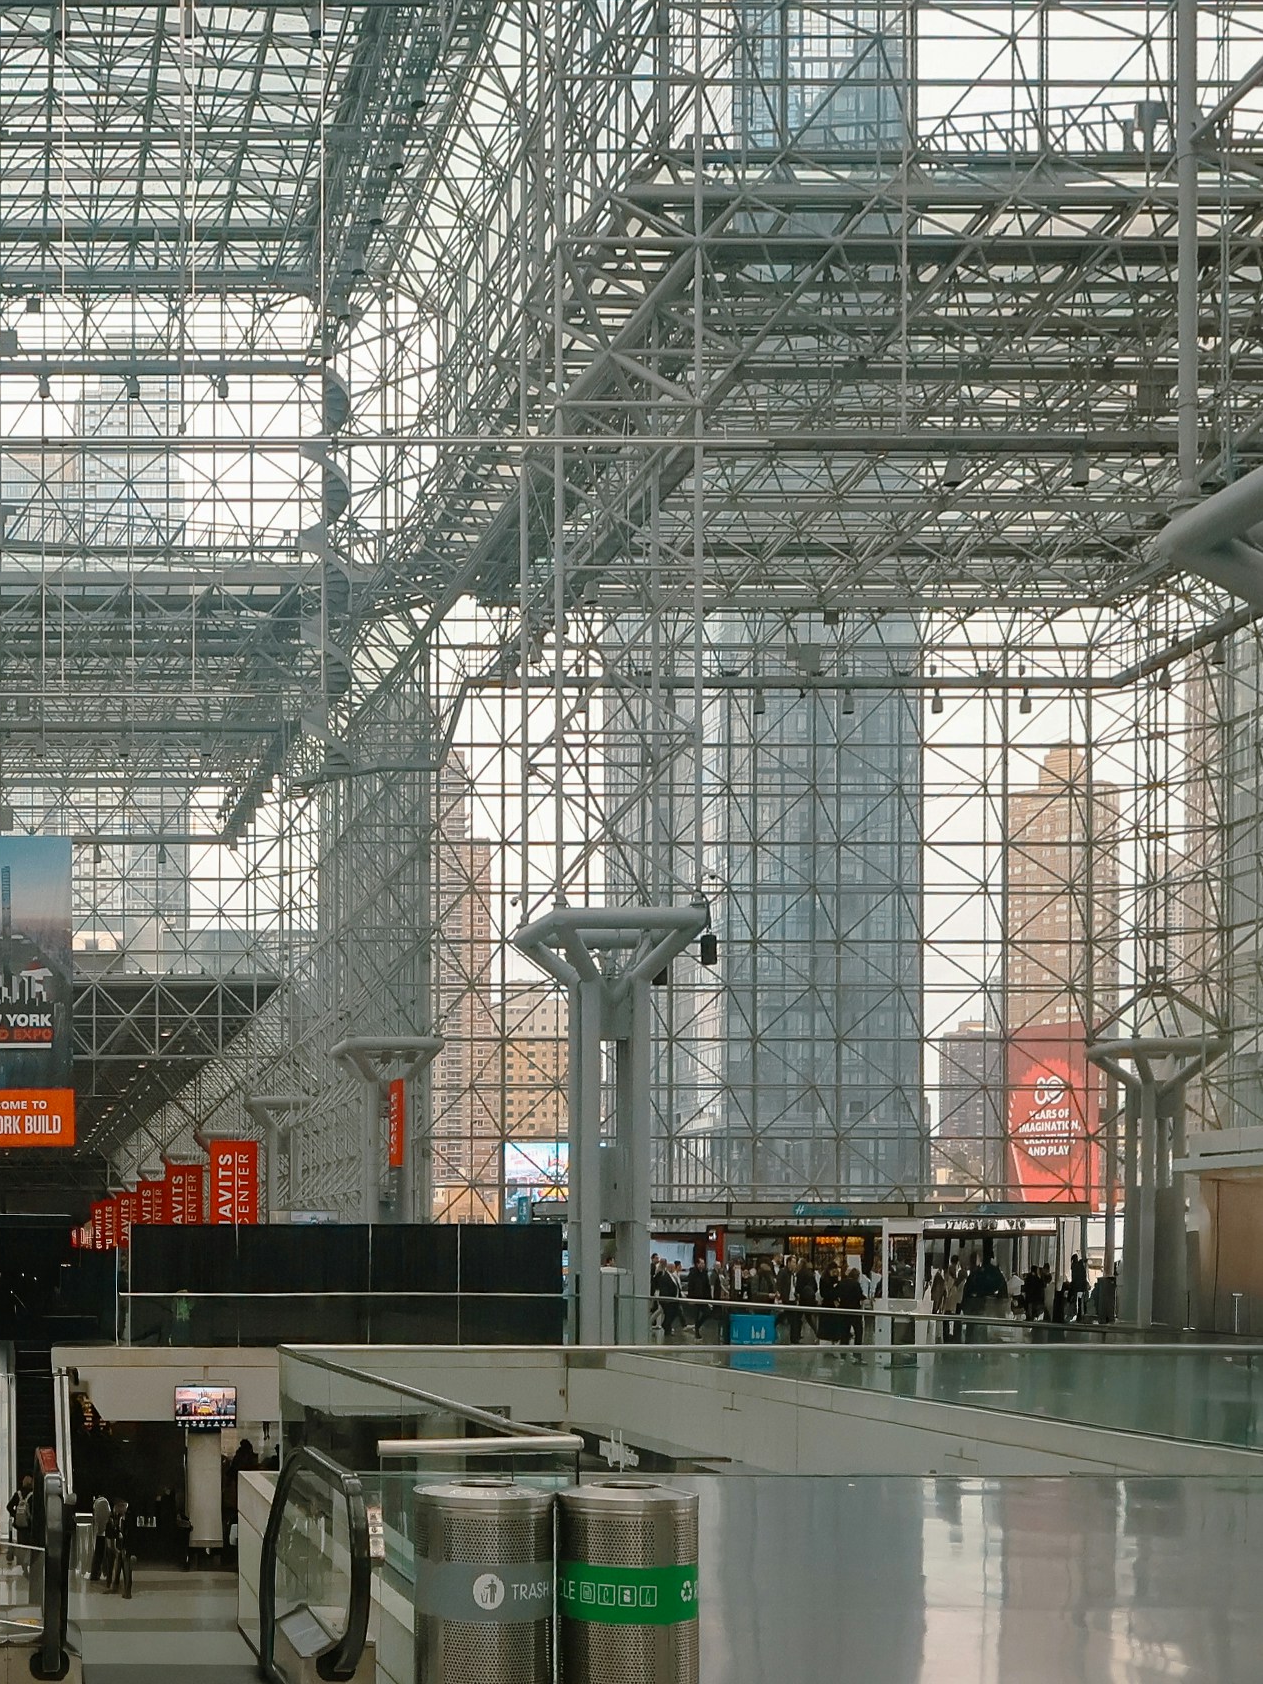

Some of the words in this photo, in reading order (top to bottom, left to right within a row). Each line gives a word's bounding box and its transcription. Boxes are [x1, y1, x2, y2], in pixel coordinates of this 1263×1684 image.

[6, 1013, 52, 1027] YORK
[14, 1028, 53, 1041] EXPO
[32, 1100, 47, 1110] TO
[1028, 1109, 1057, 1120] YEARS
[1058, 1108, 1070, 1118] OF
[24, 1115, 62, 1134] BUILD
[1028, 1146, 1047, 1156] AND
[1047, 1145, 1069, 1155] PLAY
[142, 1189, 152, 1224] VITS
[155, 1189, 163, 1221] NTER
[172, 1175, 183, 1224] AVITS
[187, 1175, 197, 1222] ENTER
[511, 1581, 549, 1601] TRASH
